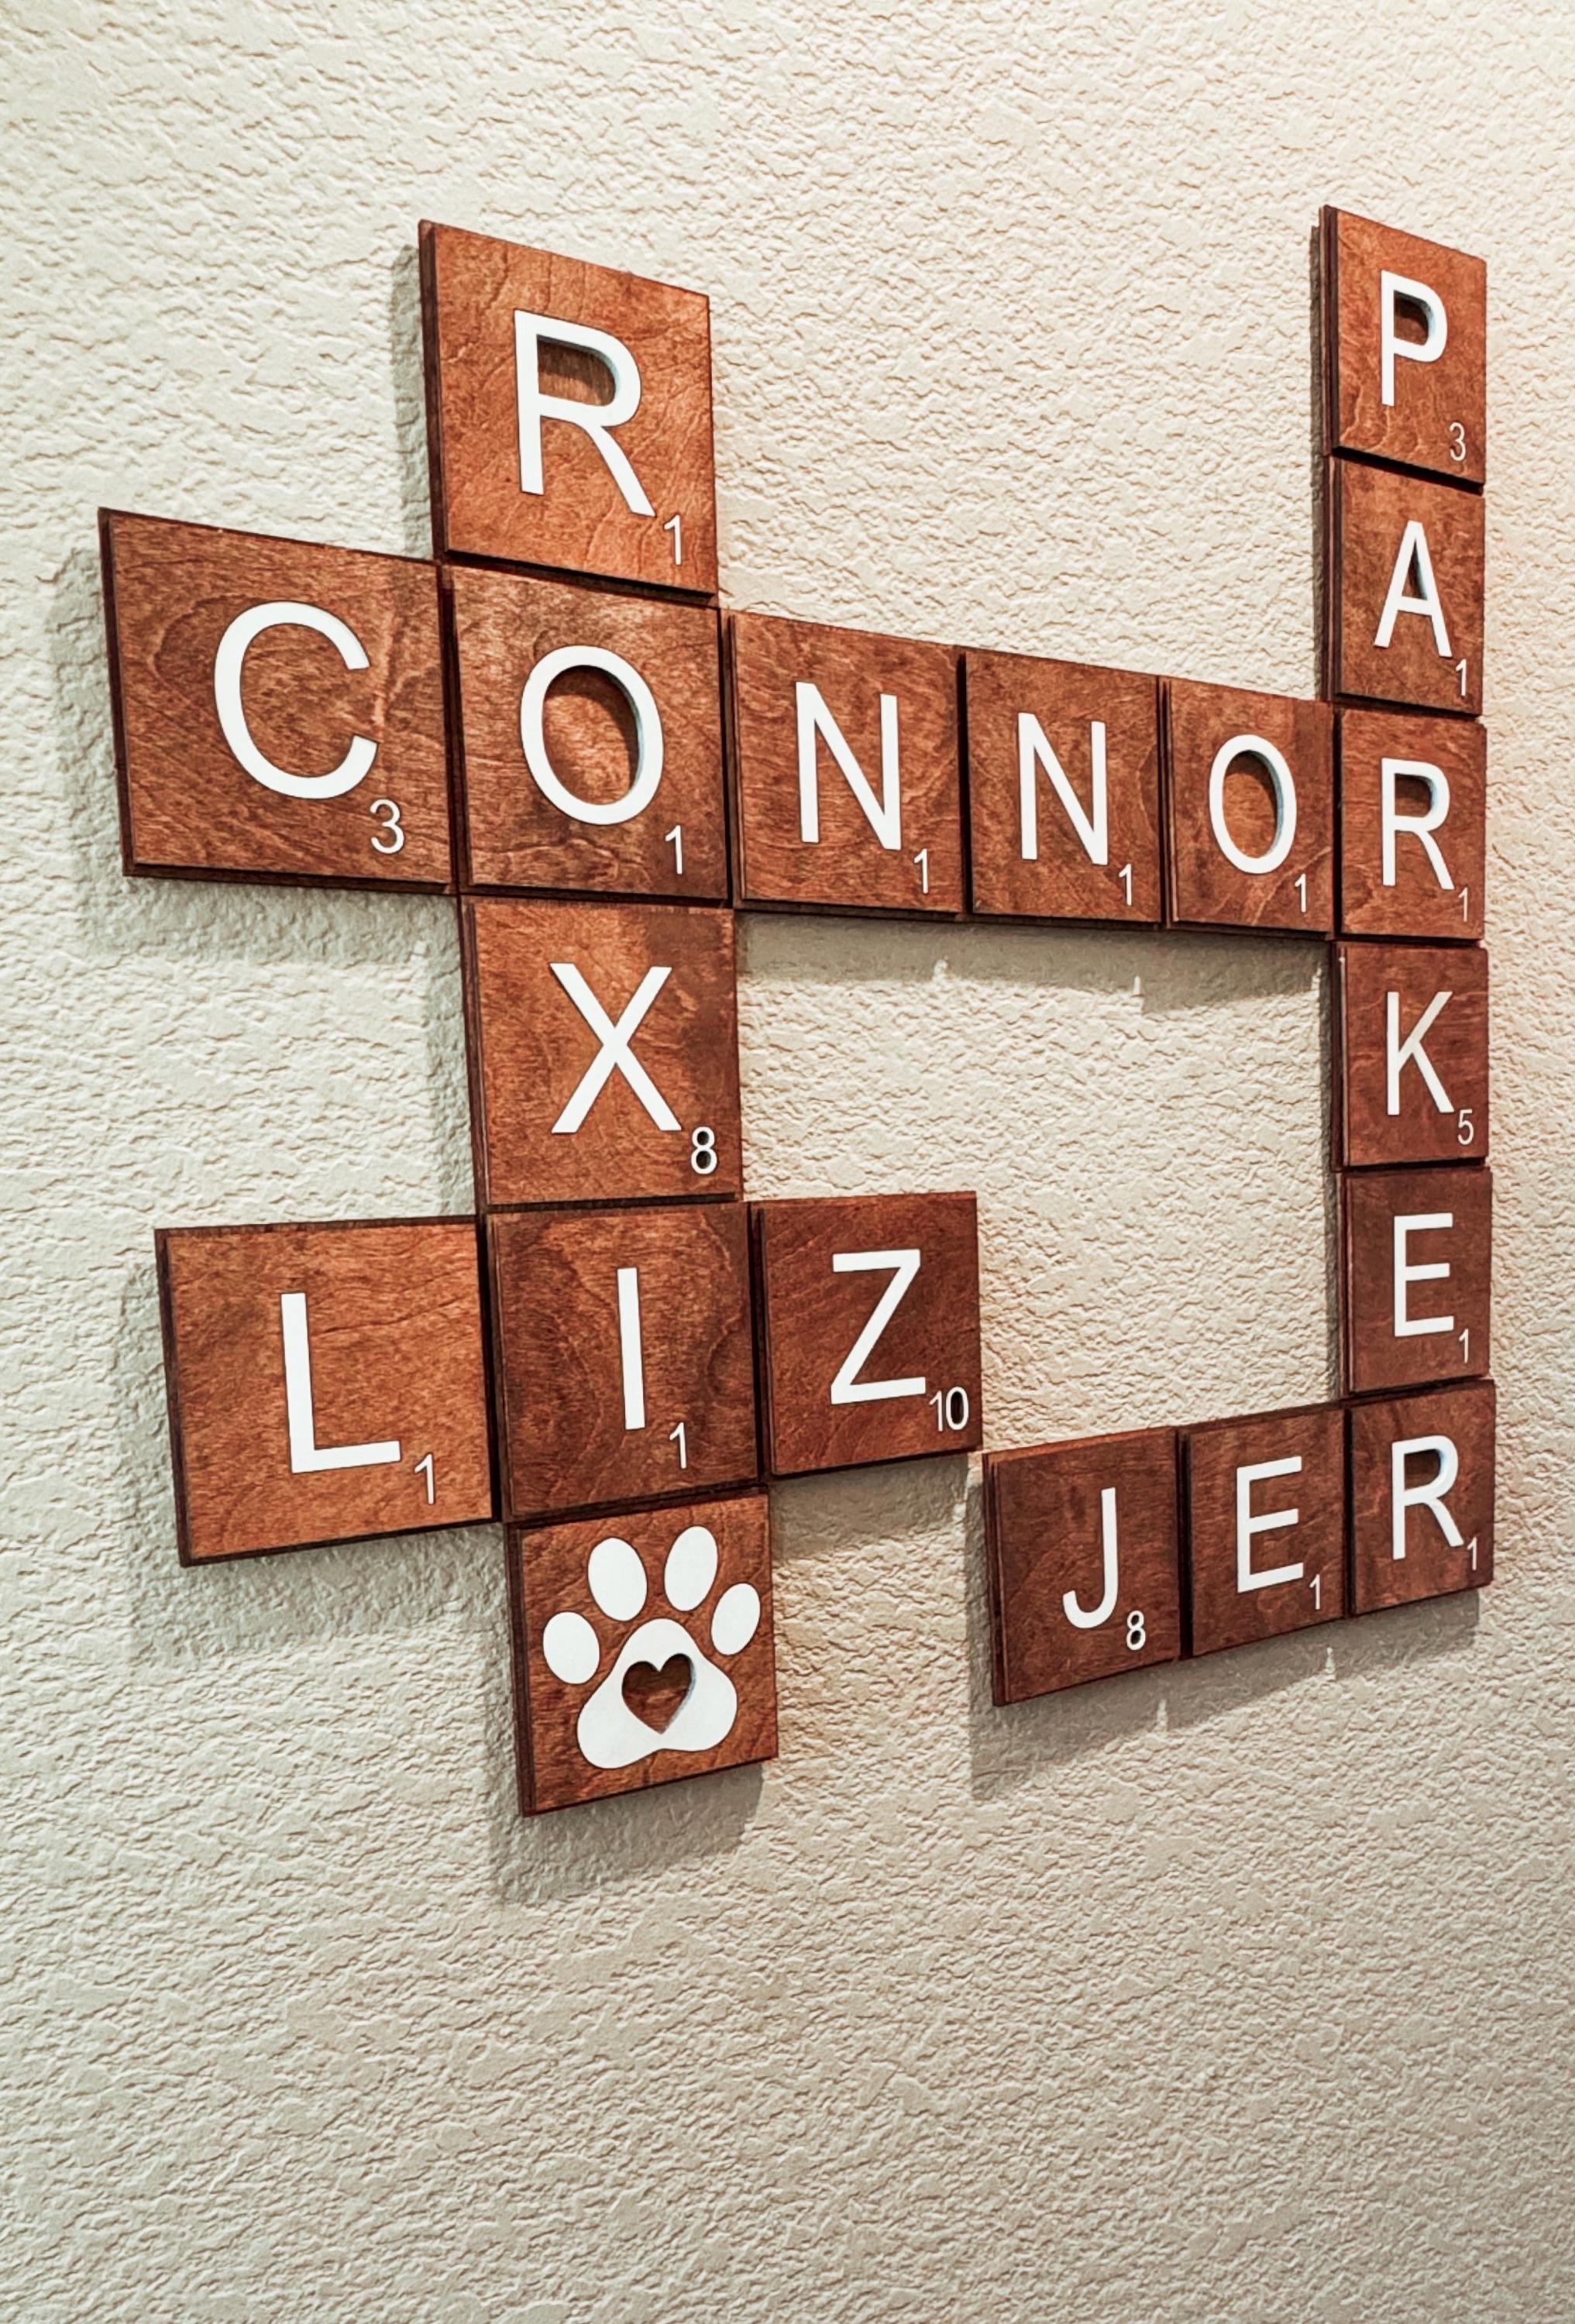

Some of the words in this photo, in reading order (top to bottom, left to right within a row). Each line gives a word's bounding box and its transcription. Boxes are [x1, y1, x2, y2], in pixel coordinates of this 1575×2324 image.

[1449, 422, 1467, 462] 3
[665, 515, 682, 565] 1
[370, 799, 404, 854] 3
[665, 825, 683, 875] 1
[913, 848, 930, 894] 1
[1119, 864, 1133, 906] 1
[1294, 874, 1306, 913] 1
[690, 1126, 718, 1175] 8
[1456, 1109, 1475, 1146] 5
[281, 1250, 925, 1473] LIZ
[929, 1387, 969, 1432] 10
[669, 1422, 686, 1469] 1
[414, 1454, 435, 1504] 1
[1126, 1611, 1147, 1651] 8
